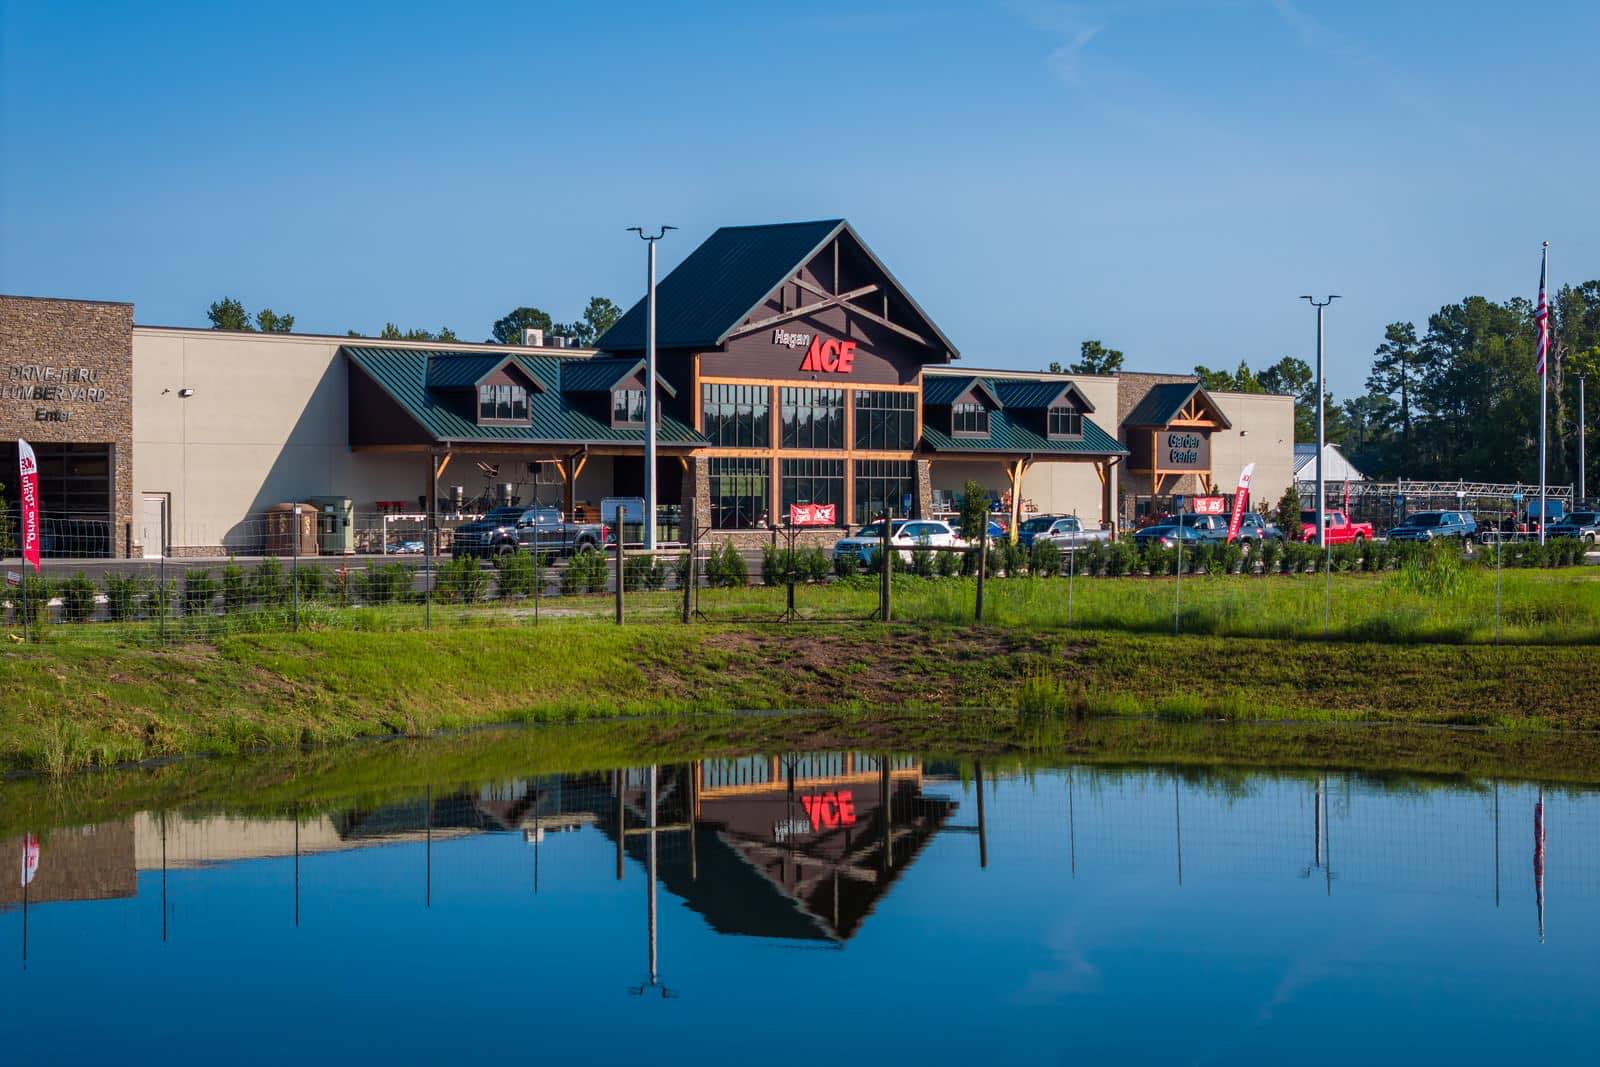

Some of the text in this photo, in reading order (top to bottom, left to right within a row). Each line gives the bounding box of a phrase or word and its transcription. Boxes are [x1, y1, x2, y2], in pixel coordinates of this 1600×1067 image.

[774, 329, 810, 349] Hagan
[800, 334, 857, 373] ACE
[35, 407, 74, 422] Enter
[1168, 432, 1200, 448] Garden
[1169, 449, 1199, 464] Center
